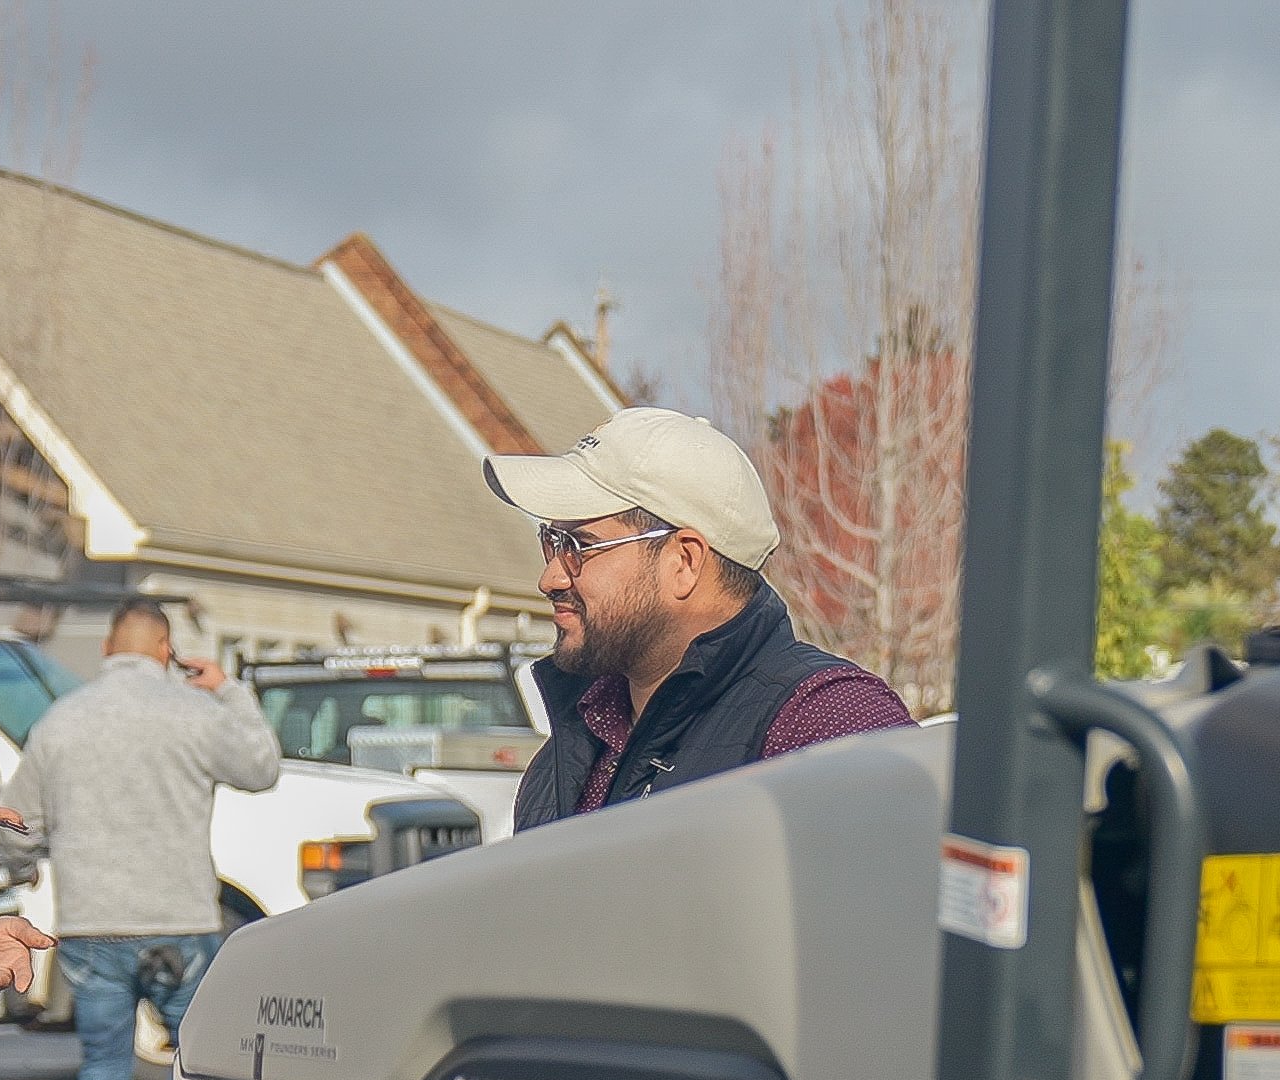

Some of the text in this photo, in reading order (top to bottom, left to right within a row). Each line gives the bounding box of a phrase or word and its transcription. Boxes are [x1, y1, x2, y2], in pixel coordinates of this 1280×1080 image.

[256, 996, 323, 1029] MONARCH
[270, 1042, 308, 1056] FOUNDERS
[310, 1046, 337, 1060] SERIES
